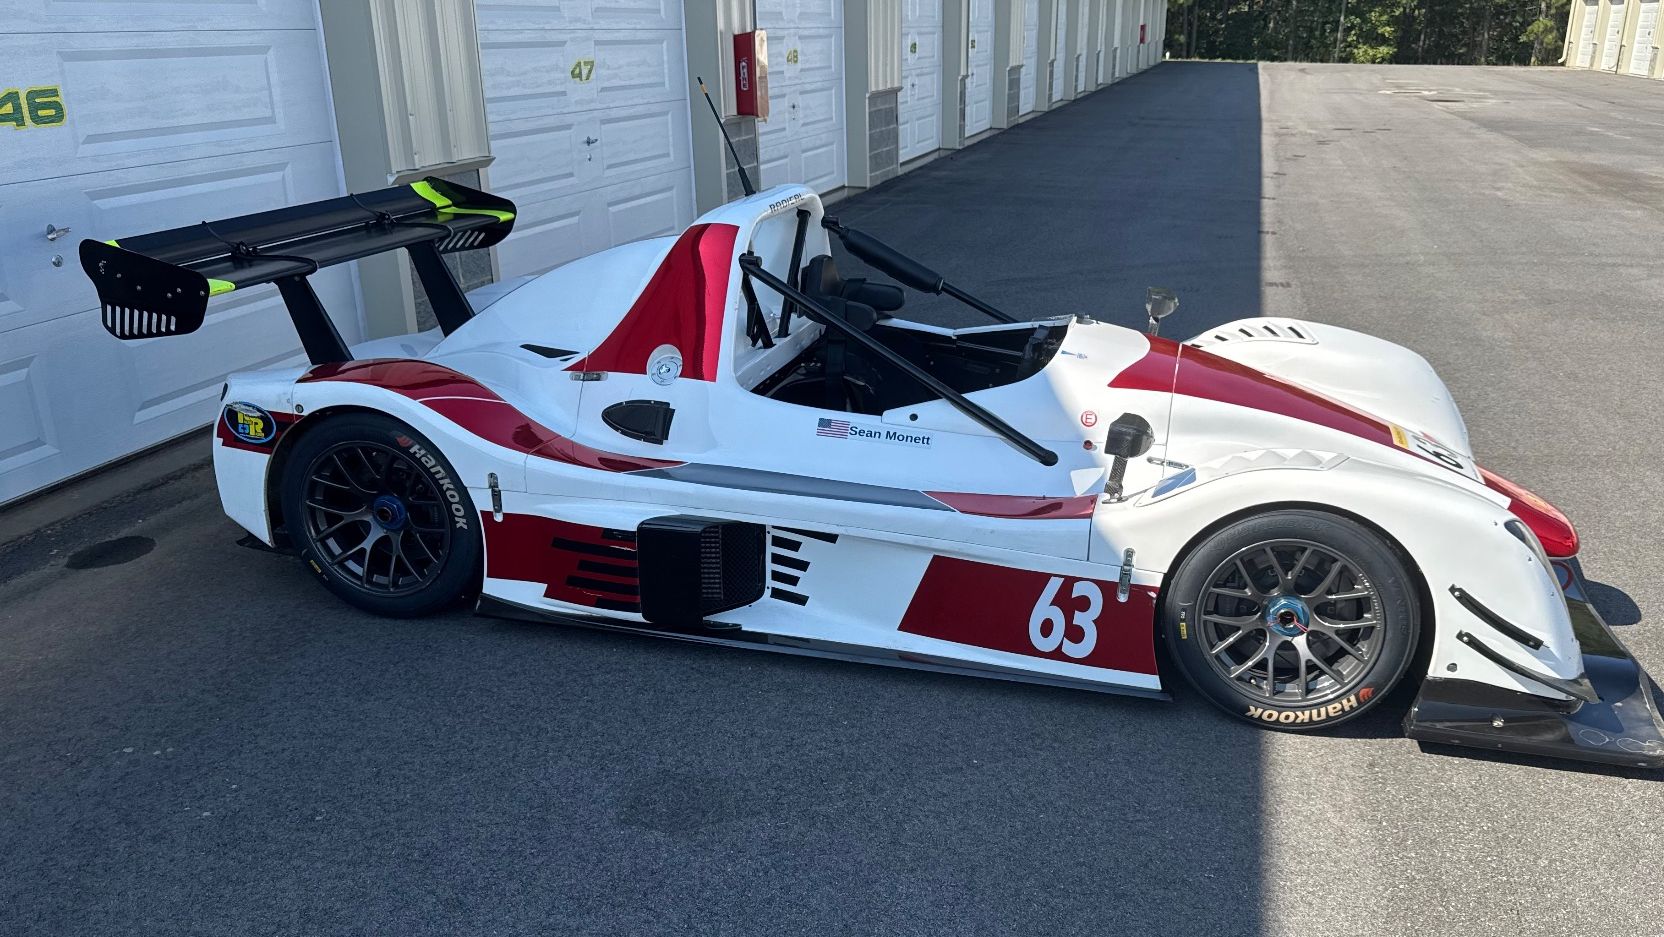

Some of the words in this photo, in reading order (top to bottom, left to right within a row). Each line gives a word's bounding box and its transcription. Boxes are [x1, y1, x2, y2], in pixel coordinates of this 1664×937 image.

[570, 58, 595, 82] 47
[786, 49, 799, 65] 48
[0, 85, 67, 130] 46
[849, 426, 881, 439] Sean
[885, 430, 930, 445] Monett
[408, 443, 468, 530] Hankook
[1028, 575, 1103, 658] 63
[1244, 693, 1358, 723] Hankook
